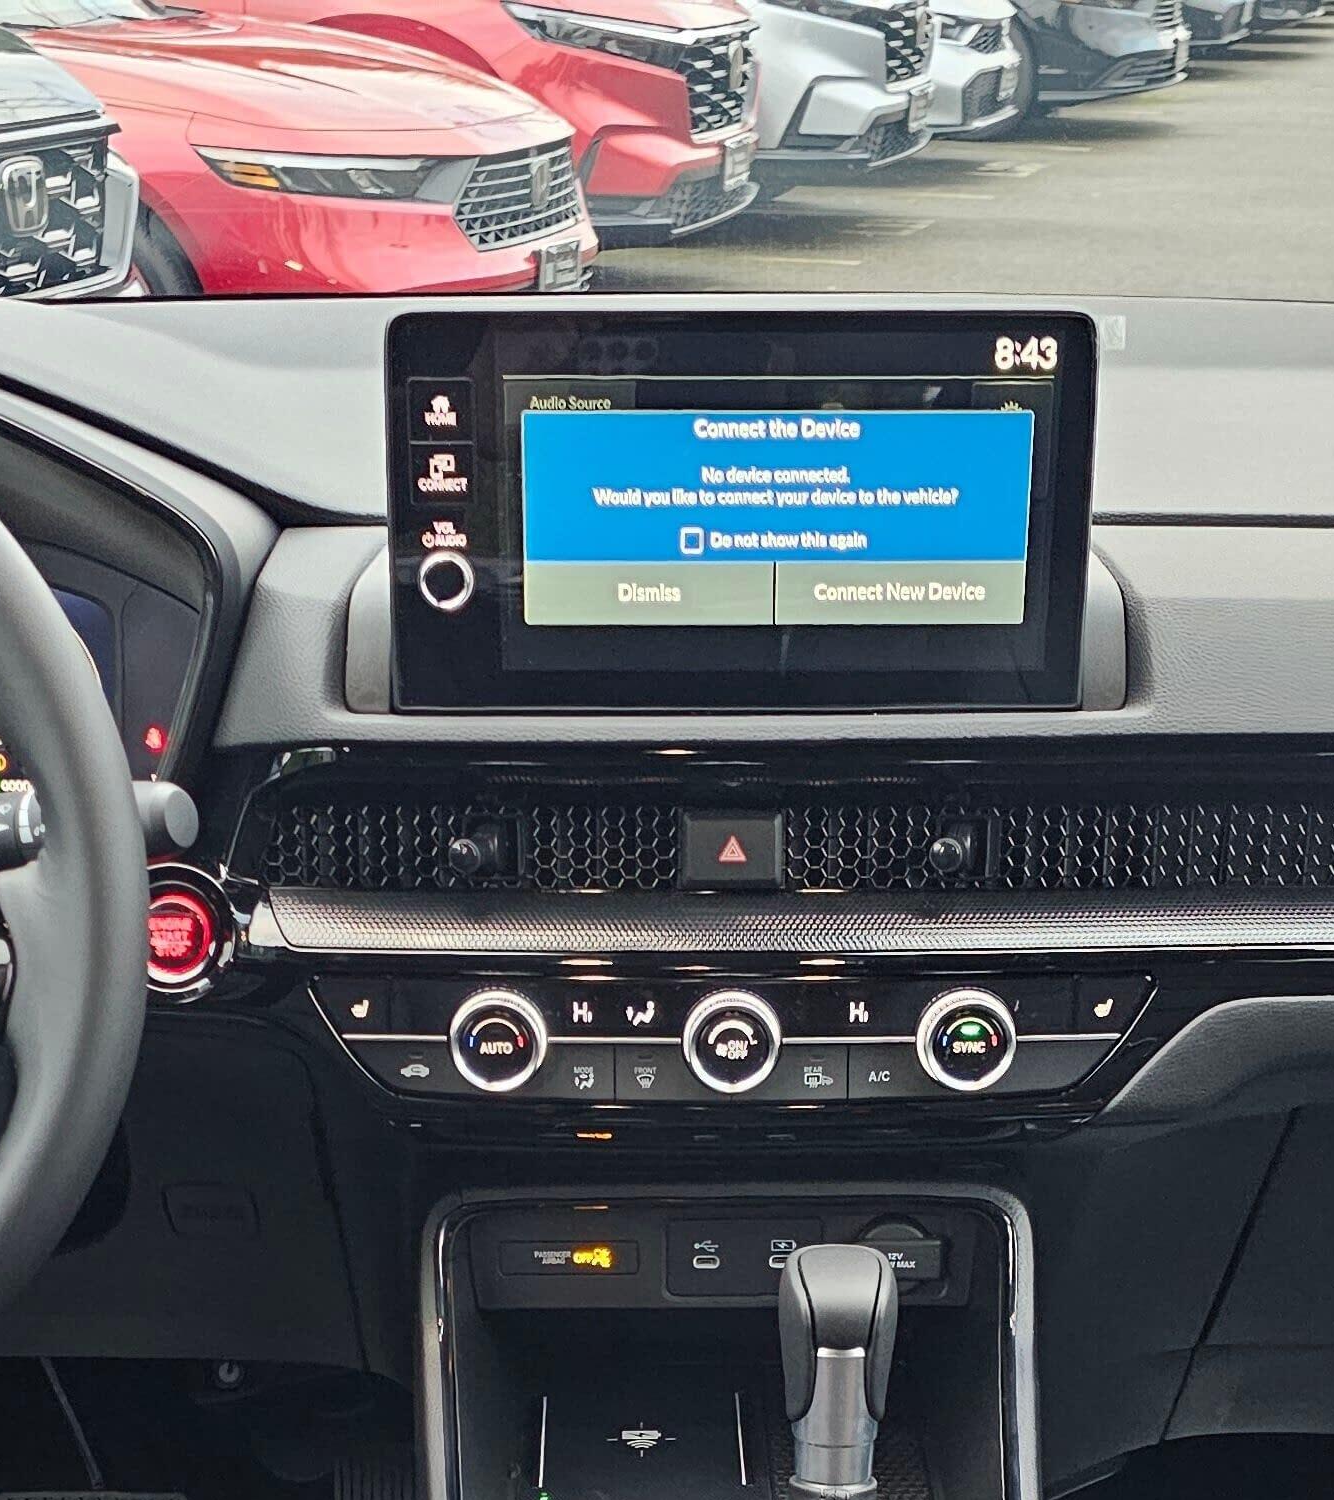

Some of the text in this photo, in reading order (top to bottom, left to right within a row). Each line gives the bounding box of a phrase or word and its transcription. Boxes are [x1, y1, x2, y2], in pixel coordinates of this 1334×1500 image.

[994, 335, 1058, 371] 8:43
[529, 395, 612, 411] Audio Source
[693, 417, 862, 440] Connect the Device
[700, 465, 851, 485] No device connected.
[417, 477, 468, 492] CONNECT
[592, 486, 960, 509] Would you like to connect your device to the vehicle?
[434, 533, 468, 547] AUDIO
[709, 530, 868, 551] Do not show this again
[617, 582, 682, 602] Dismiss
[813, 581, 986, 602] Connect New Device
[479, 1041, 513, 1056] AUTO
[952, 1040, 986, 1054] SYNC
[573, 1066, 595, 1075] MODE
[633, 1066, 658, 1076] FRONT
[868, 1070, 891, 1082] A/C
[887, 1252, 904, 1261] 12V
[896, 1260, 916, 1269] MAX
